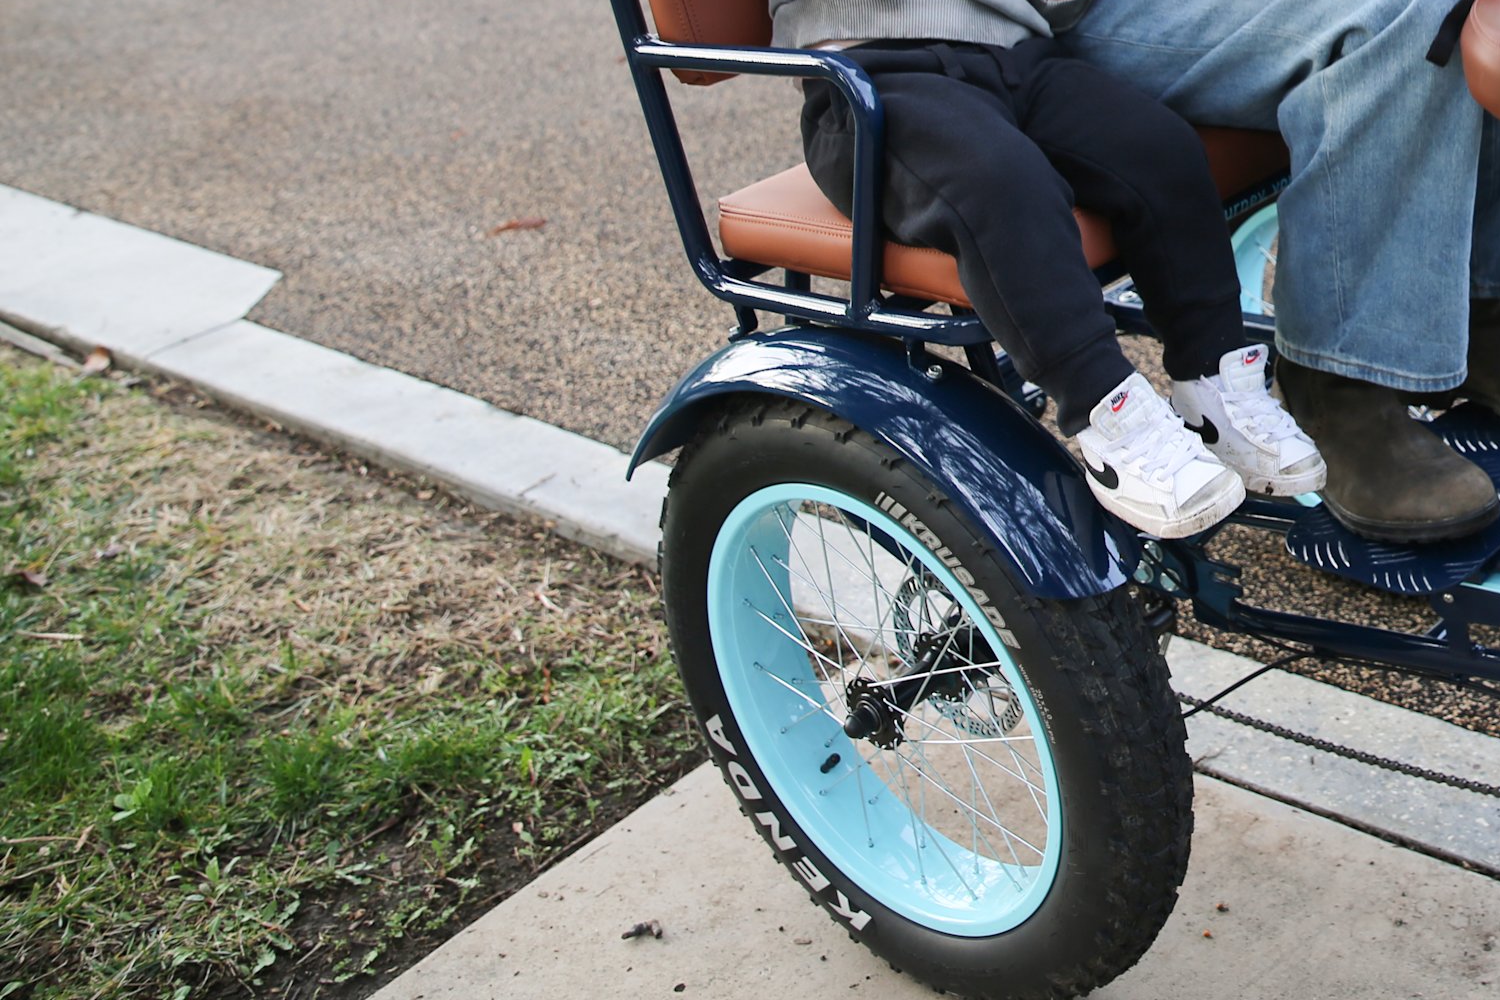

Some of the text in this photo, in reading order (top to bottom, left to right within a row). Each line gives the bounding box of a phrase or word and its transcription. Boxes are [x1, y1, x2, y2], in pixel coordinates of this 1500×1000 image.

[901, 512, 1021, 650] KRUSADE
[1018, 663, 1032, 686] WIRE
[705, 713, 872, 931] KENDA
